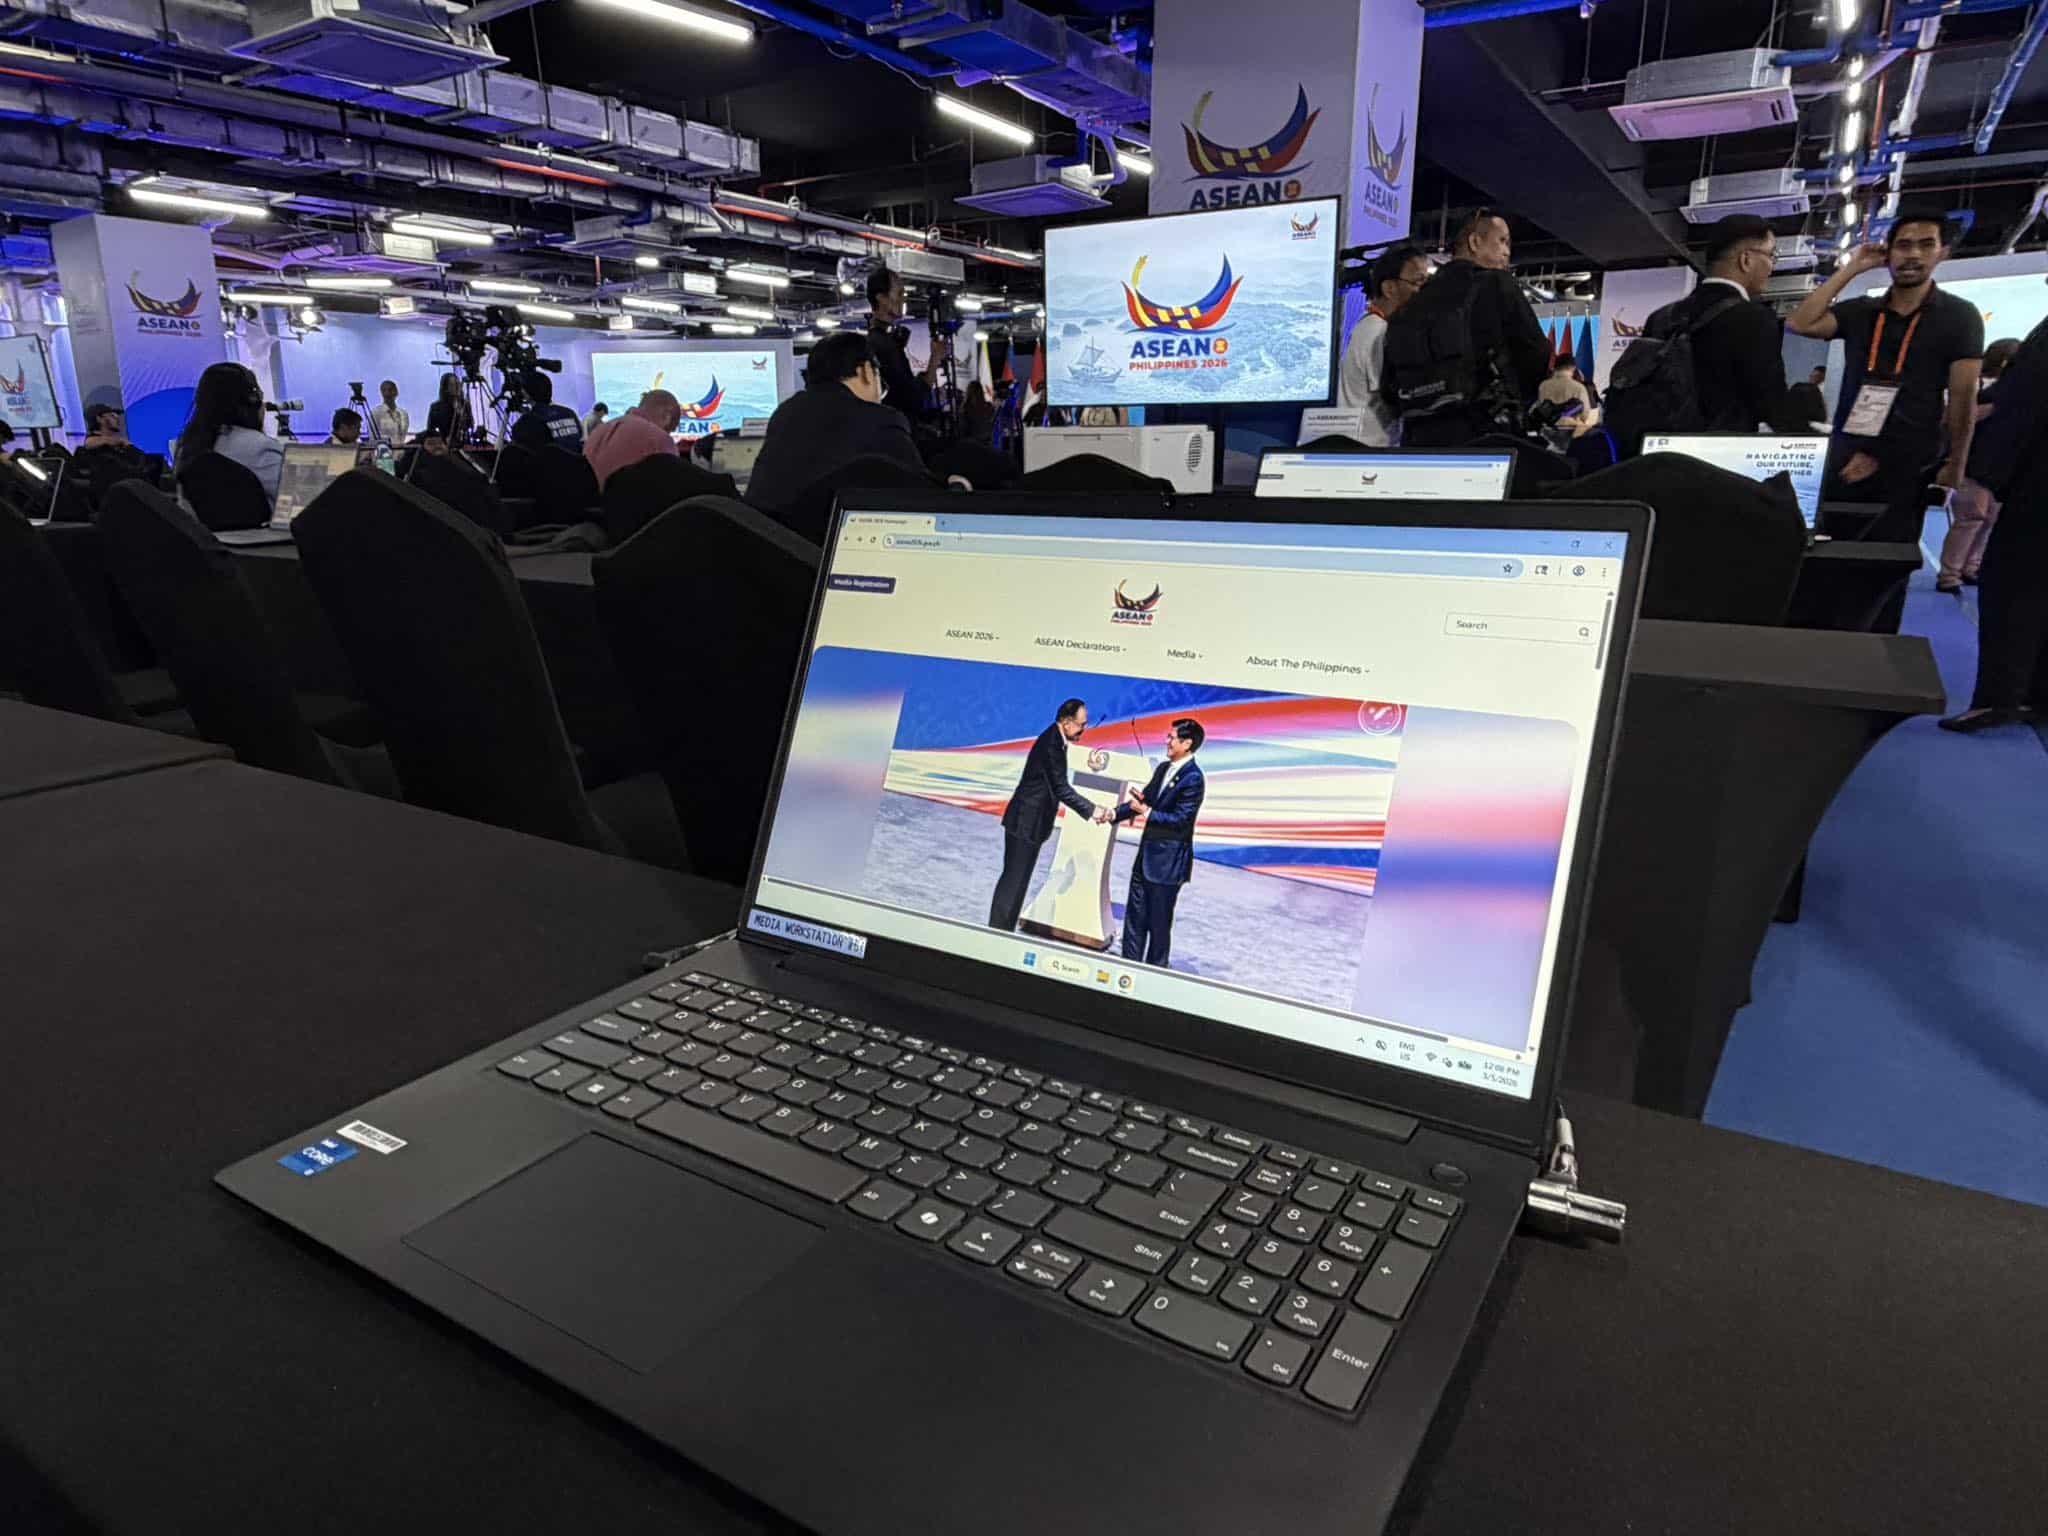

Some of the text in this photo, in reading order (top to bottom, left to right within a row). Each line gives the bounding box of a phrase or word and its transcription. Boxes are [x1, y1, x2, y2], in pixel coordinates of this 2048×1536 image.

[1190, 180, 1281, 209] ASEAN
[1364, 181, 1393, 209] ASEAN
[137, 317, 190, 330] ASEAN
[1131, 338, 1211, 359] ASEAN
[1129, 360, 1198, 371] PHILIPPINES
[678, 422, 709, 434] EAN
[1745, 453, 1816, 461] NAVIGATING
[1112, 611, 1146, 620] ASEAN
[1456, 620, 1488, 630] Search
[946, 629, 972, 639] ASEAN
[1035, 637, 1120, 653] ASEAN Declarations
[1167, 649, 1196, 659] Media
[1246, 656, 1362, 675] About The Philippines
[753, 914, 781, 931] MEDIA
[785, 922, 843, 948] WORKSTATION
[674, 1011, 689, 1020] Q
[707, 1021, 726, 1031] W
[740, 1032, 756, 1041] E
[701, 1081, 716, 1091] C
[791, 1079, 807, 1089] G
[892, 1080, 908, 1089] U
[829, 1092, 847, 1102] H
[775, 1106, 791, 1117] B
[871, 1106, 887, 1116] J
[978, 1109, 994, 1119] O
[817, 1121, 835, 1133] N
[1023, 1122, 1039, 1132] P
[859, 1137, 880, 1150] M
[1239, 1191, 1253, 1202] 7
[1159, 1210, 1191, 1226] Enter
[1287, 1208, 1301, 1220] 8
[1214, 1224, 1227, 1235] 4
[1338, 1226, 1353, 1238] 9
[1134, 1244, 1163, 1261] Shift
[1263, 1240, 1280, 1253] 5
[1190, 1256, 1200, 1269] 1
[1317, 1259, 1333, 1272] 6
[1237, 1275, 1255, 1289] 2
[1153, 1296, 1169, 1310] 0
[1292, 1295, 1309, 1309] 3
[1331, 1347, 1370, 1370] Enter
